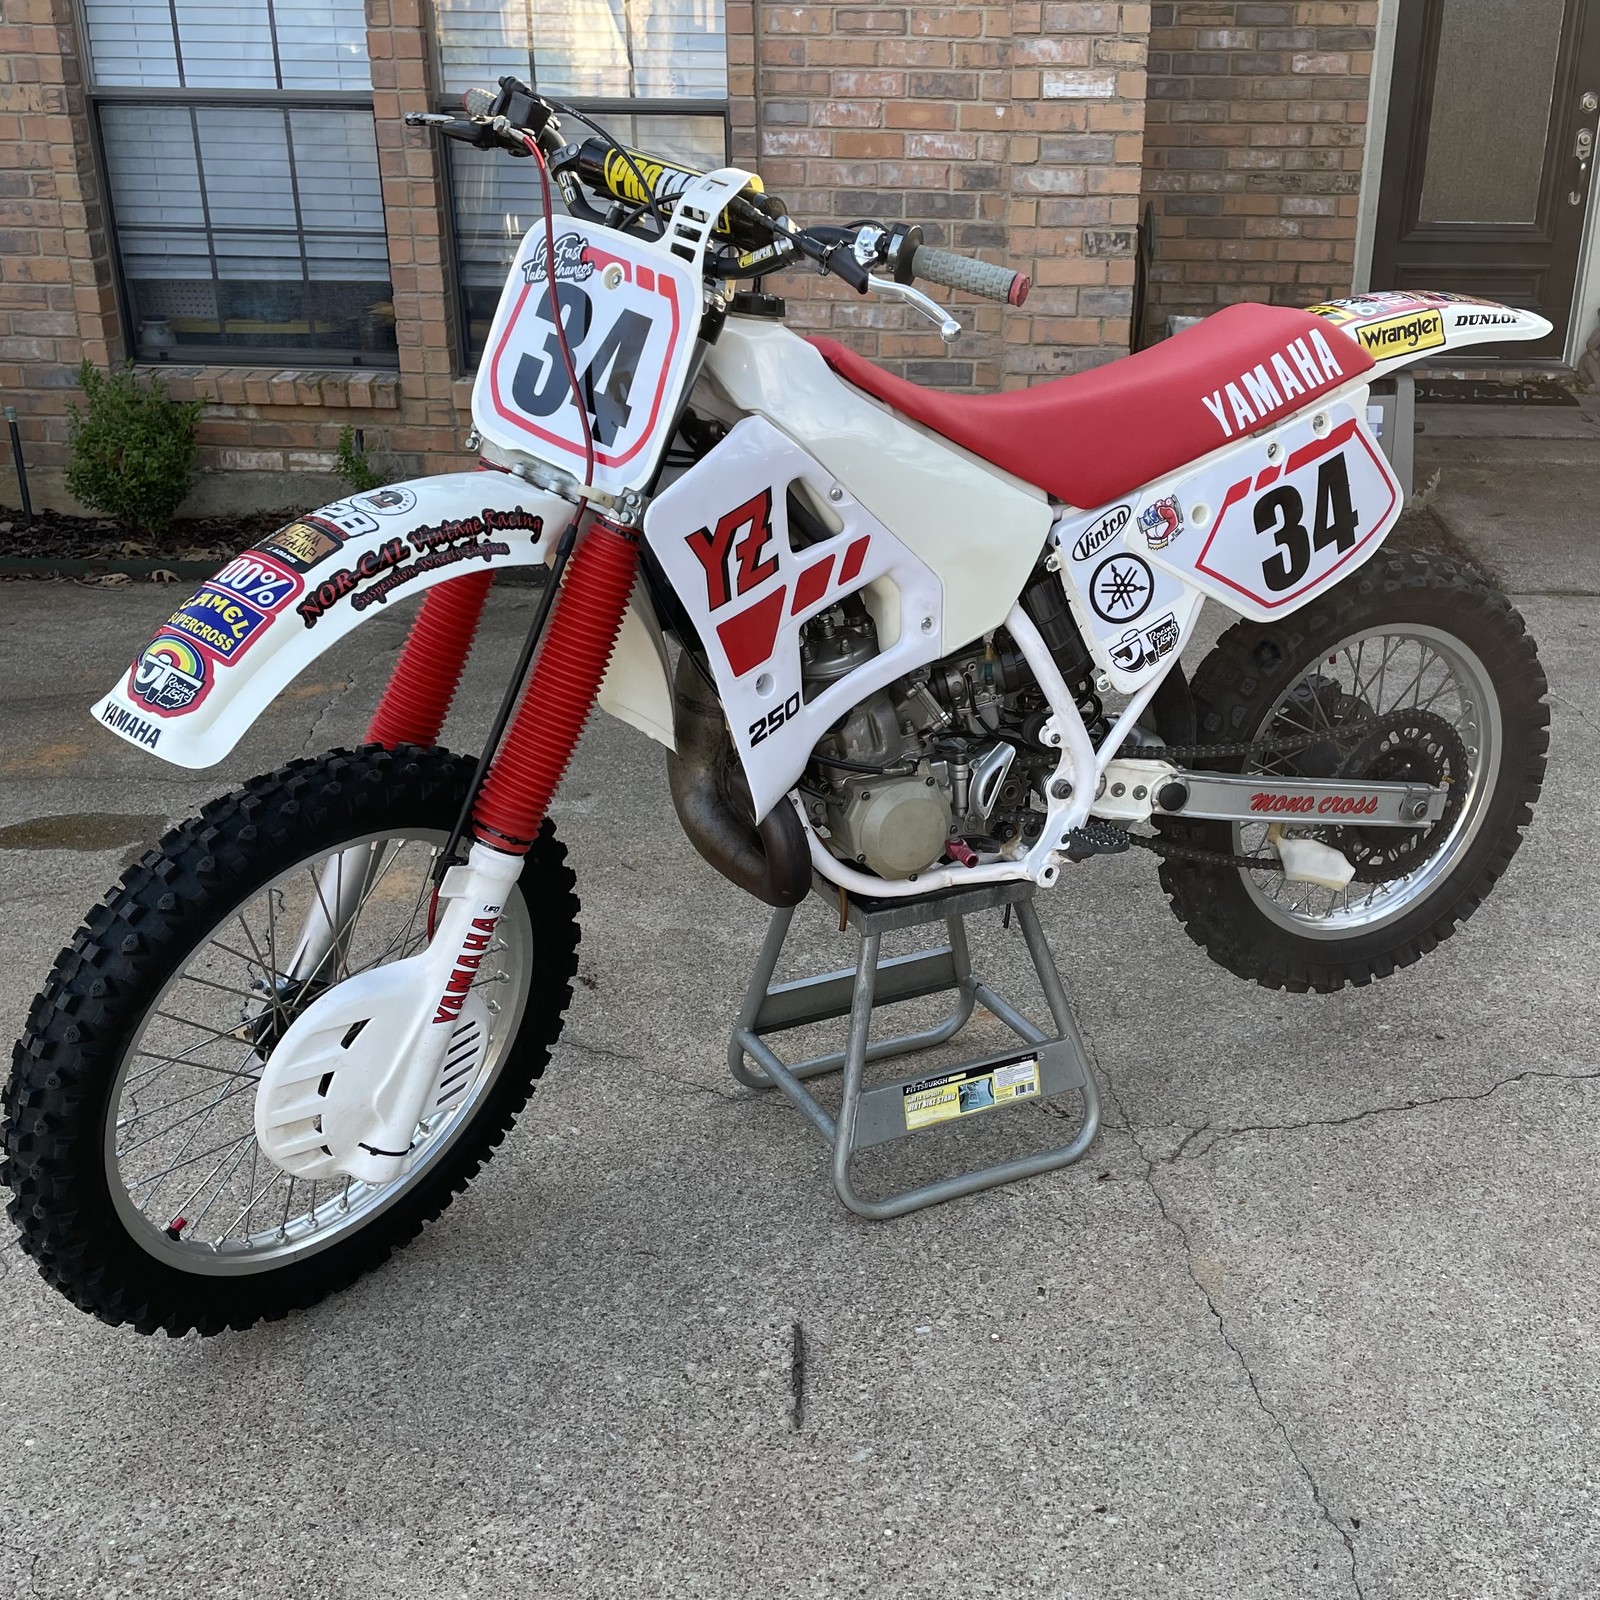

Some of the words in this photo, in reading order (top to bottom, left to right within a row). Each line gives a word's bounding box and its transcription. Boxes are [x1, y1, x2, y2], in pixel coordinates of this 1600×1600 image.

[1361, 316, 1439, 347] Wrangler
[512, 282, 652, 447] 34
[1201, 328, 1344, 437] YAMAHA
[1078, 509, 1127, 559] Vintco
[1253, 451, 1359, 592] 34
[299, 540, 411, 626] NOR-CAL
[409, 518, 482, 549] Vintage
[483, 506, 543, 543] Racing
[684, 486, 779, 612] YZ
[213, 558, 290, 605] 100%
[168, 612, 235, 651] SUPERCROSS
[180, 593, 249, 639] CAMEL
[1150, 623, 1177, 642] Racing
[168, 674, 197, 698] Racing
[101, 700, 162, 749] YAMAHA
[749, 691, 800, 748] 250
[432, 916, 499, 1024] YAMAHA
[905, 1076, 948, 1094] PITTSBURGH
